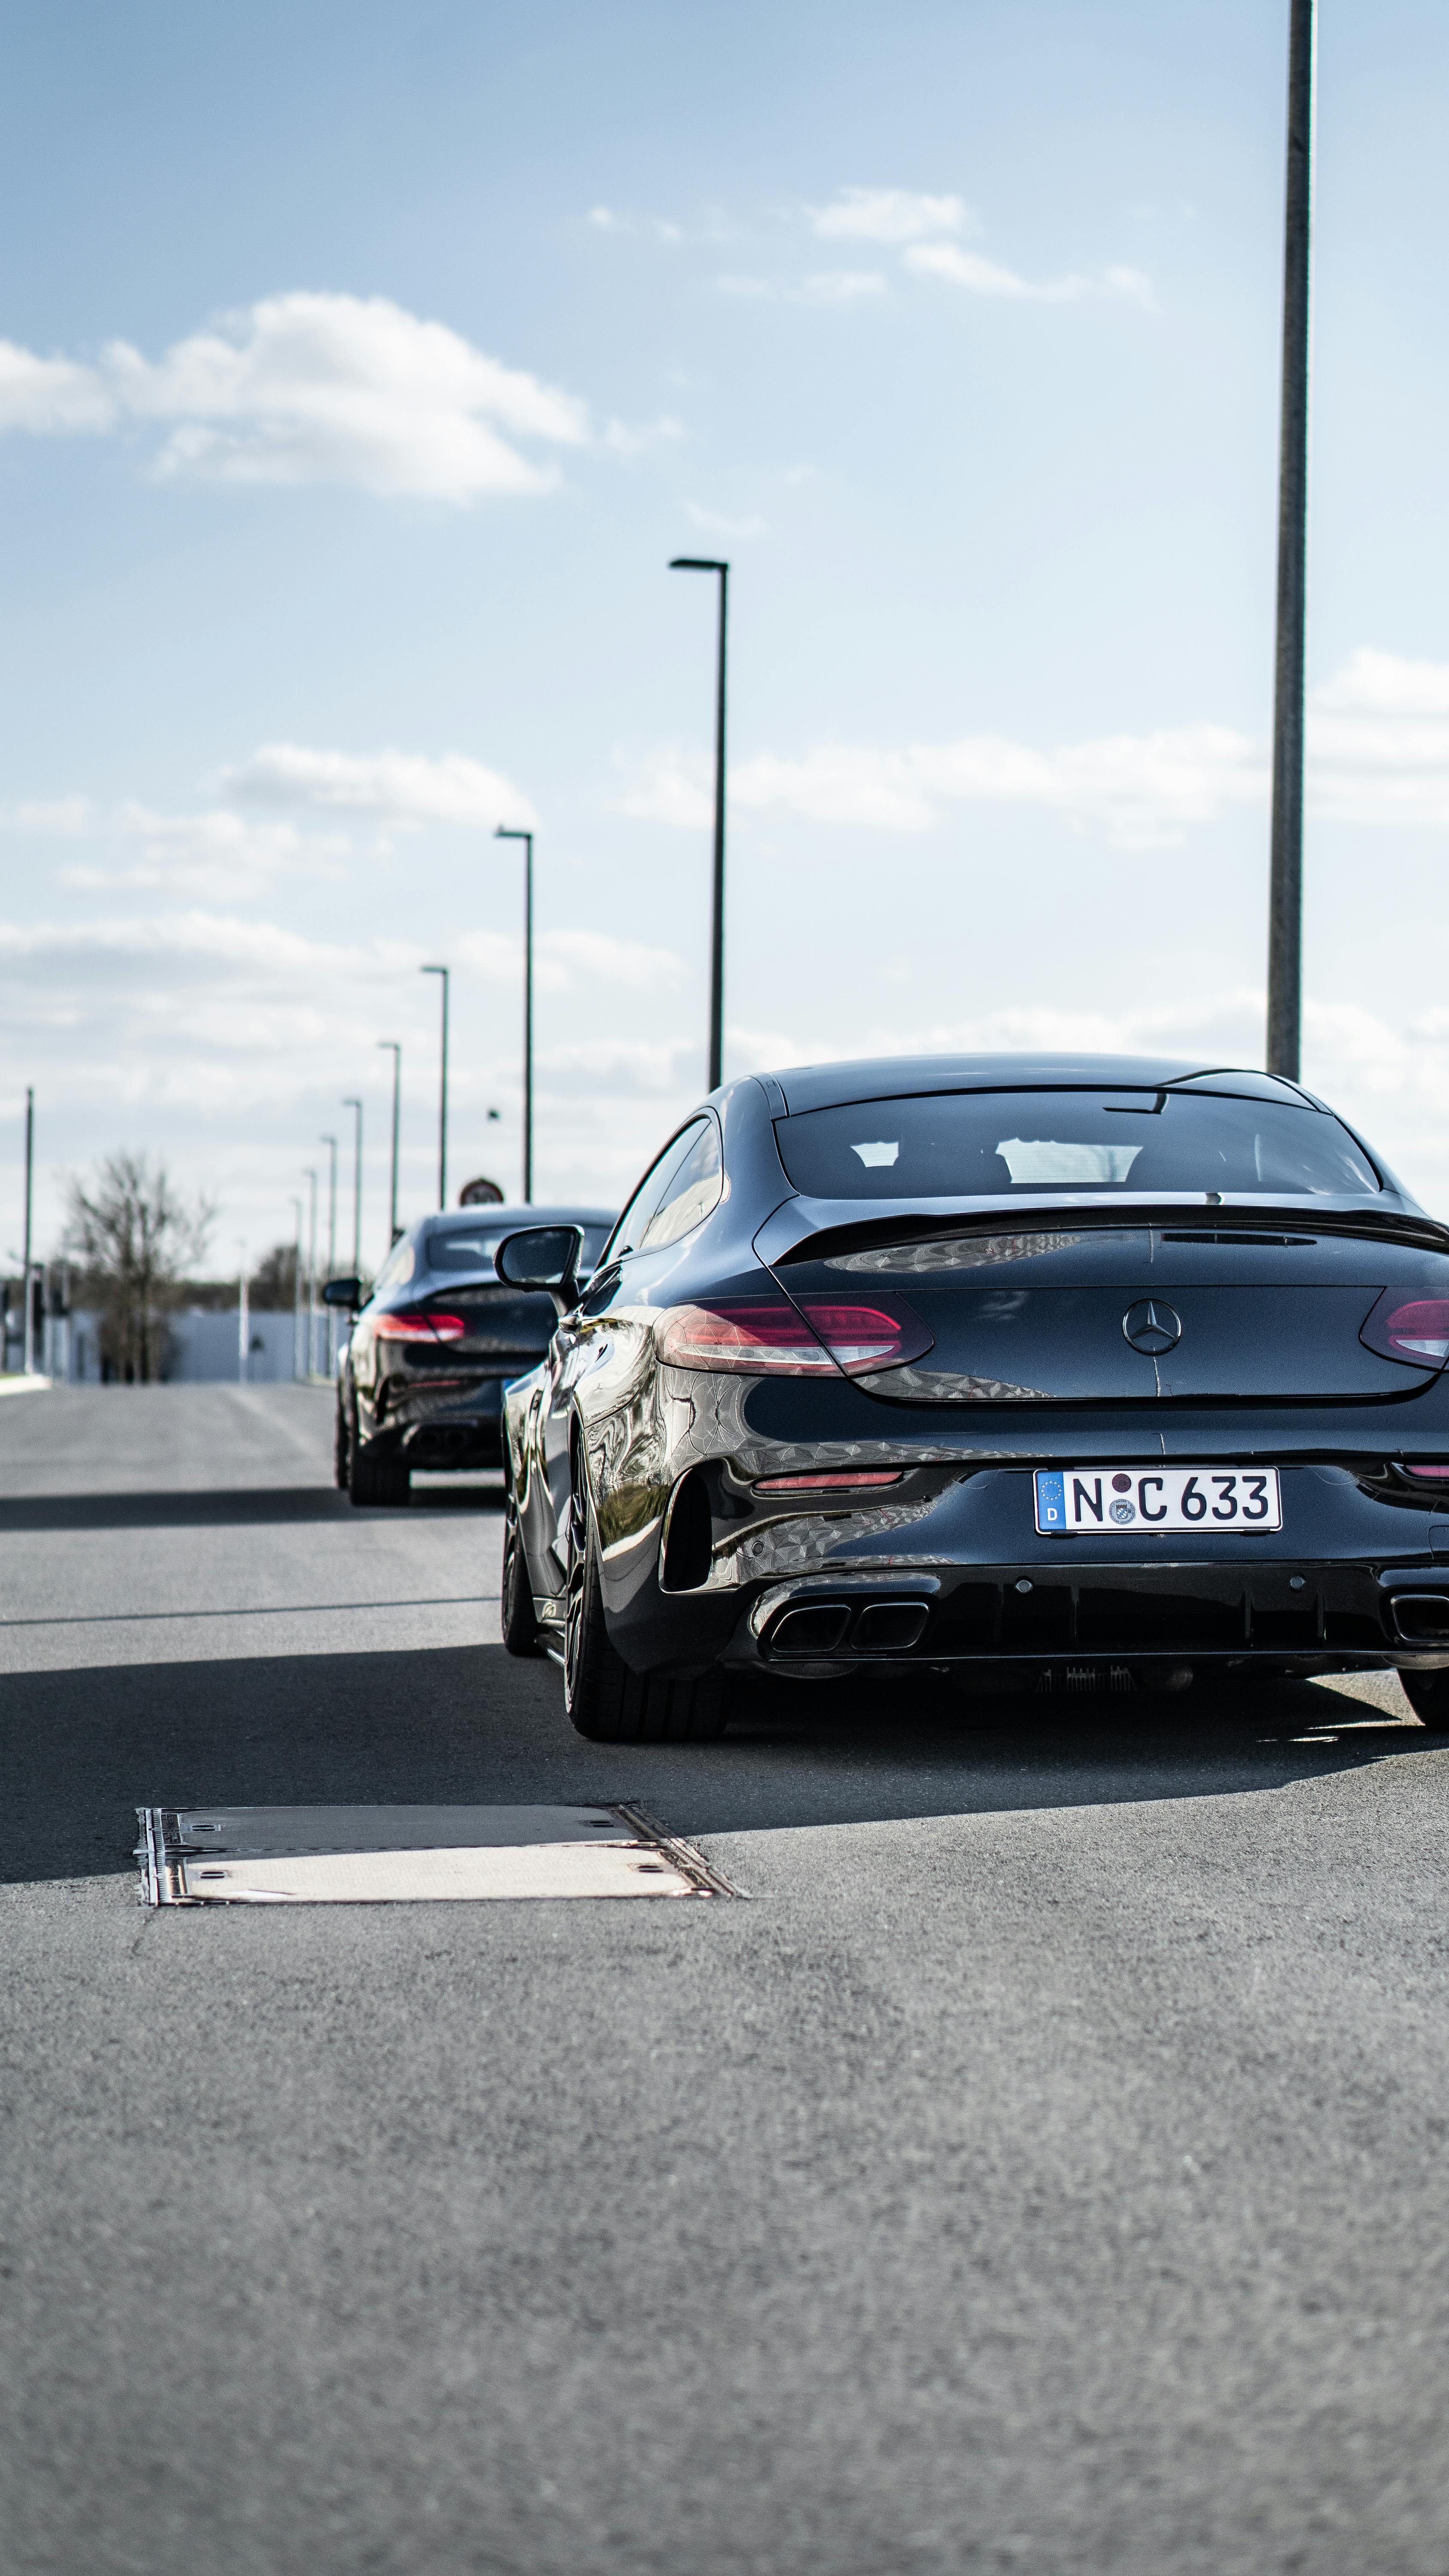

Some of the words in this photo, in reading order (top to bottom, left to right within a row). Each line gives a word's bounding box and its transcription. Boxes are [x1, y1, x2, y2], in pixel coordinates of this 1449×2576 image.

[1073, 1478, 1103, 1522] N
[1138, 1477, 1167, 1521] C
[1181, 1476, 1268, 1521] 633
[1047, 1508, 1058, 1521] D
